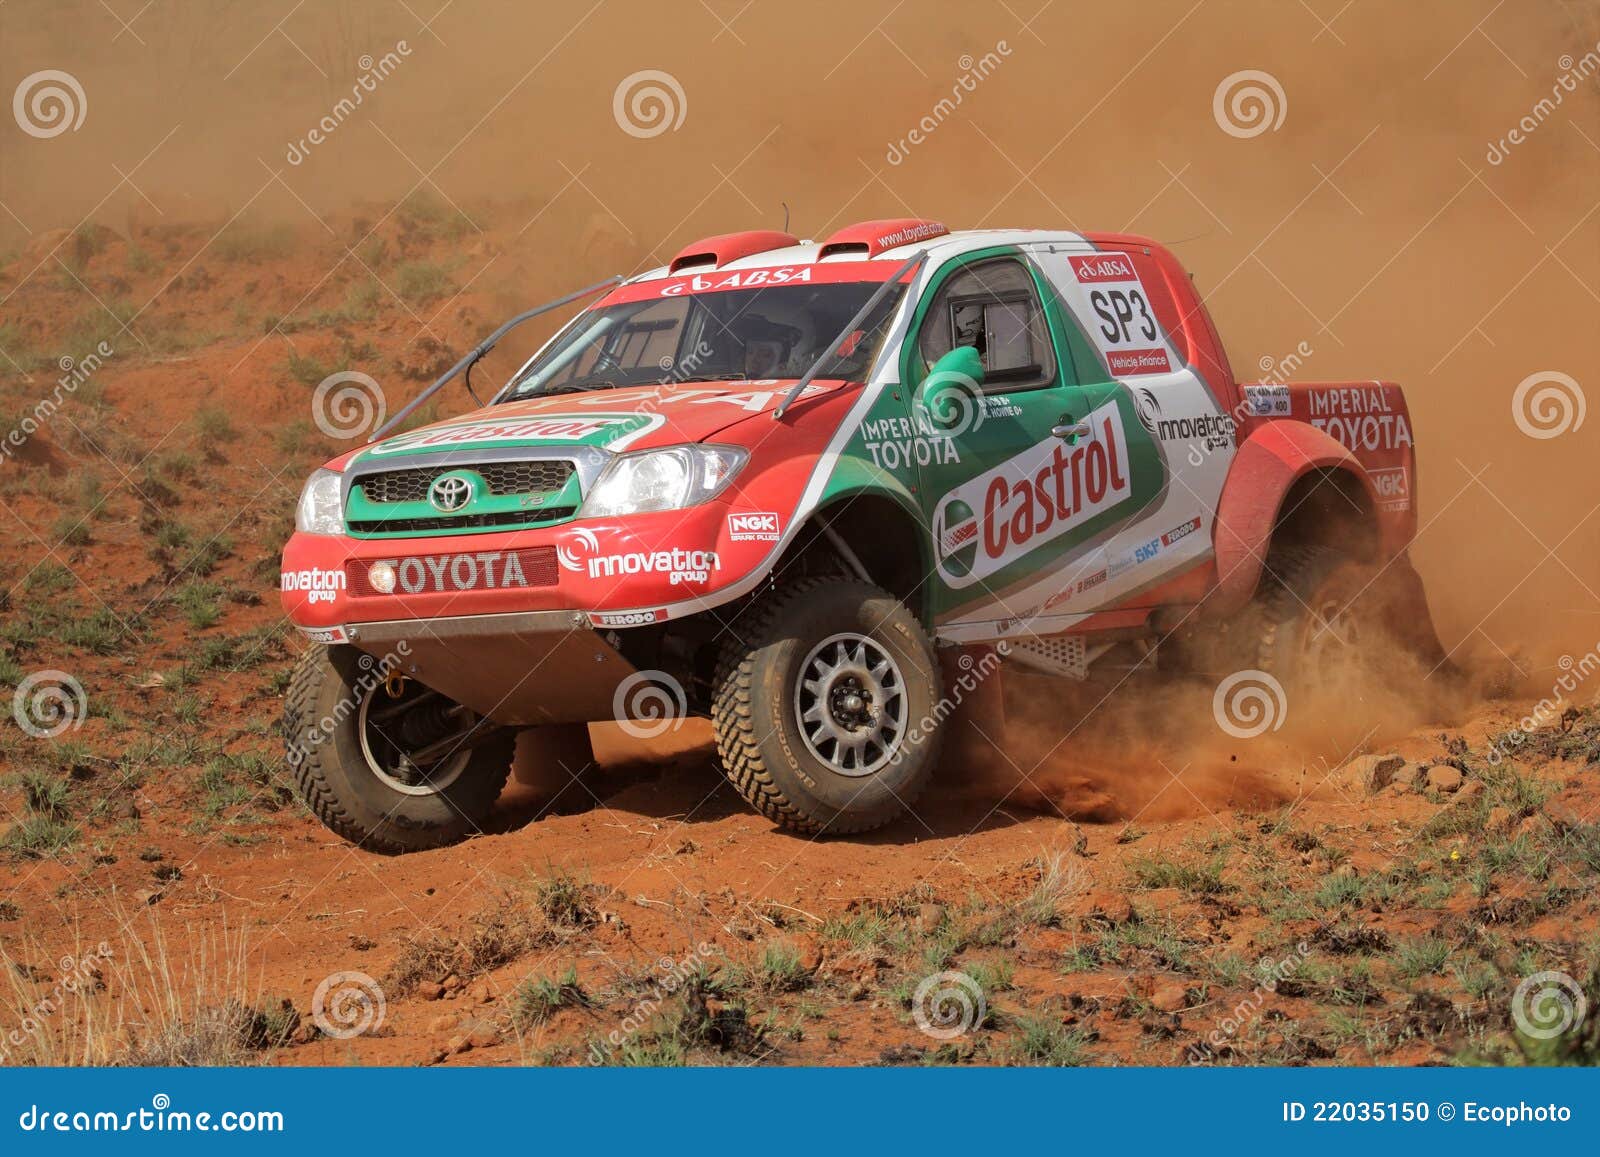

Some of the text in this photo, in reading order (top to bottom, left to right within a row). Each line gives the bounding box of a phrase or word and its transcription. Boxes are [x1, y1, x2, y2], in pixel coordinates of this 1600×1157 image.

[714, 267, 812, 289] ABSA
[1097, 261, 1131, 277] ABSA
[1090, 289, 1157, 344] SP3
[1111, 355, 1167, 369] Vehicle Finance
[1275, 400, 1288, 412] 400
[1308, 388, 1392, 415] IMPERIAL
[422, 420, 610, 444] Castrol
[859, 414, 940, 441] IMPERIAL
[865, 437, 961, 470] TOYOTA
[983, 416, 1126, 560] Castrol
[732, 515, 776, 532] NGK
[731, 534, 756, 542] SPARK
[1135, 538, 1161, 564] SKF
[587, 547, 721, 578] innovation
[670, 571, 708, 585] group
[308, 590, 336, 604] group
[601, 611, 655, 625] FERODO
